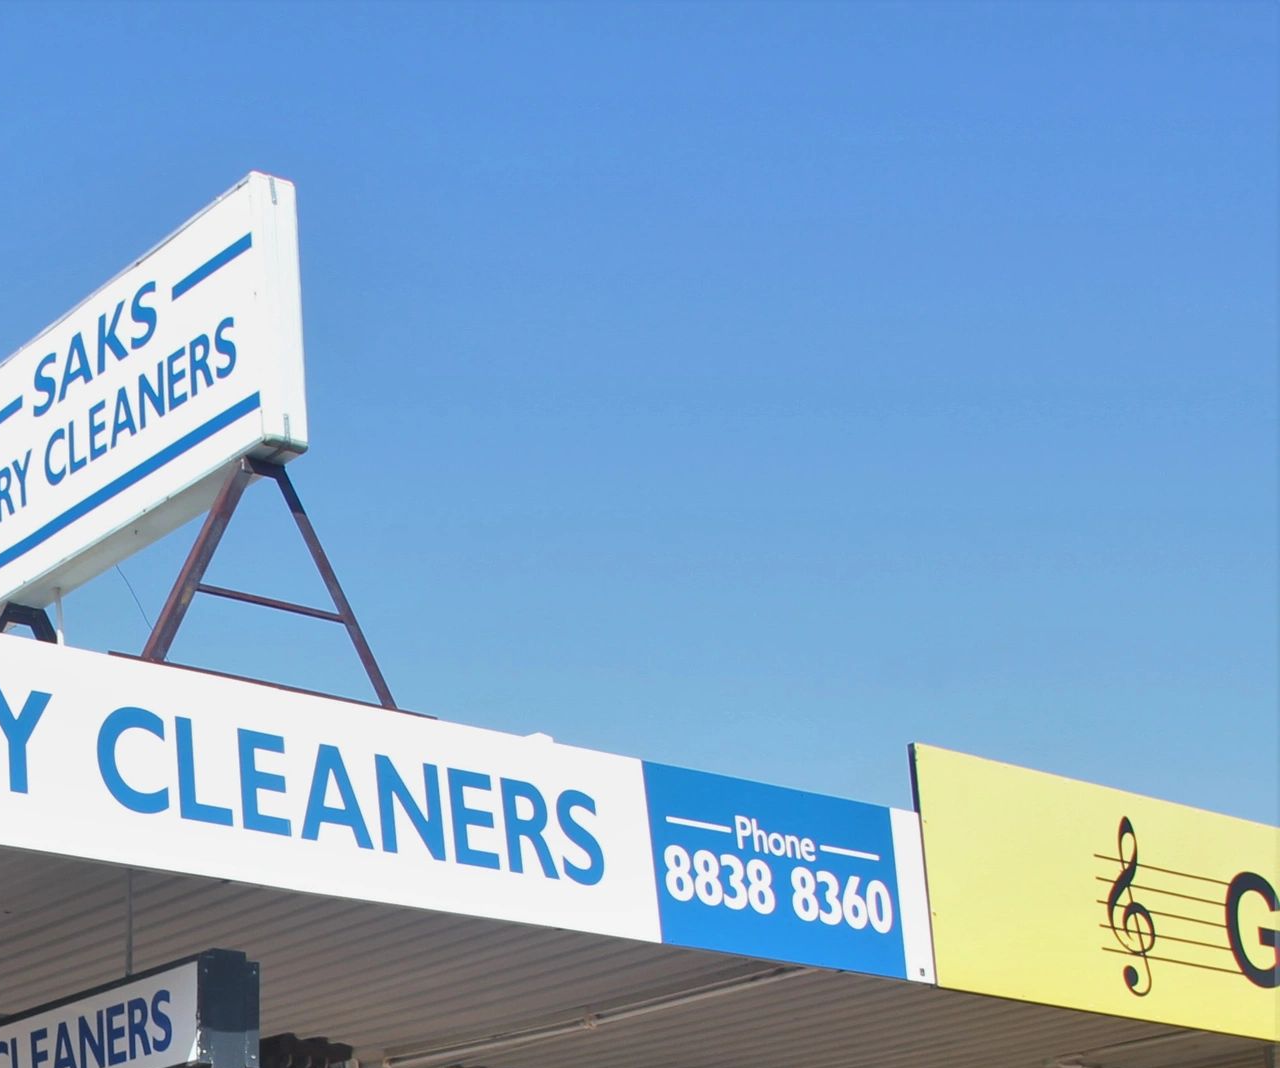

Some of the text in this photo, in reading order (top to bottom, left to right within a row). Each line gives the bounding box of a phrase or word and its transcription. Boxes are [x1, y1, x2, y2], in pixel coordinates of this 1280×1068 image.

[33, 281, 157, 418] SAKS
[43, 317, 237, 486] CLEANERS
[96, 706, 606, 886] CLEANERS
[733, 815, 817, 861] Phone
[663, 845, 893, 934] 8838 8360
